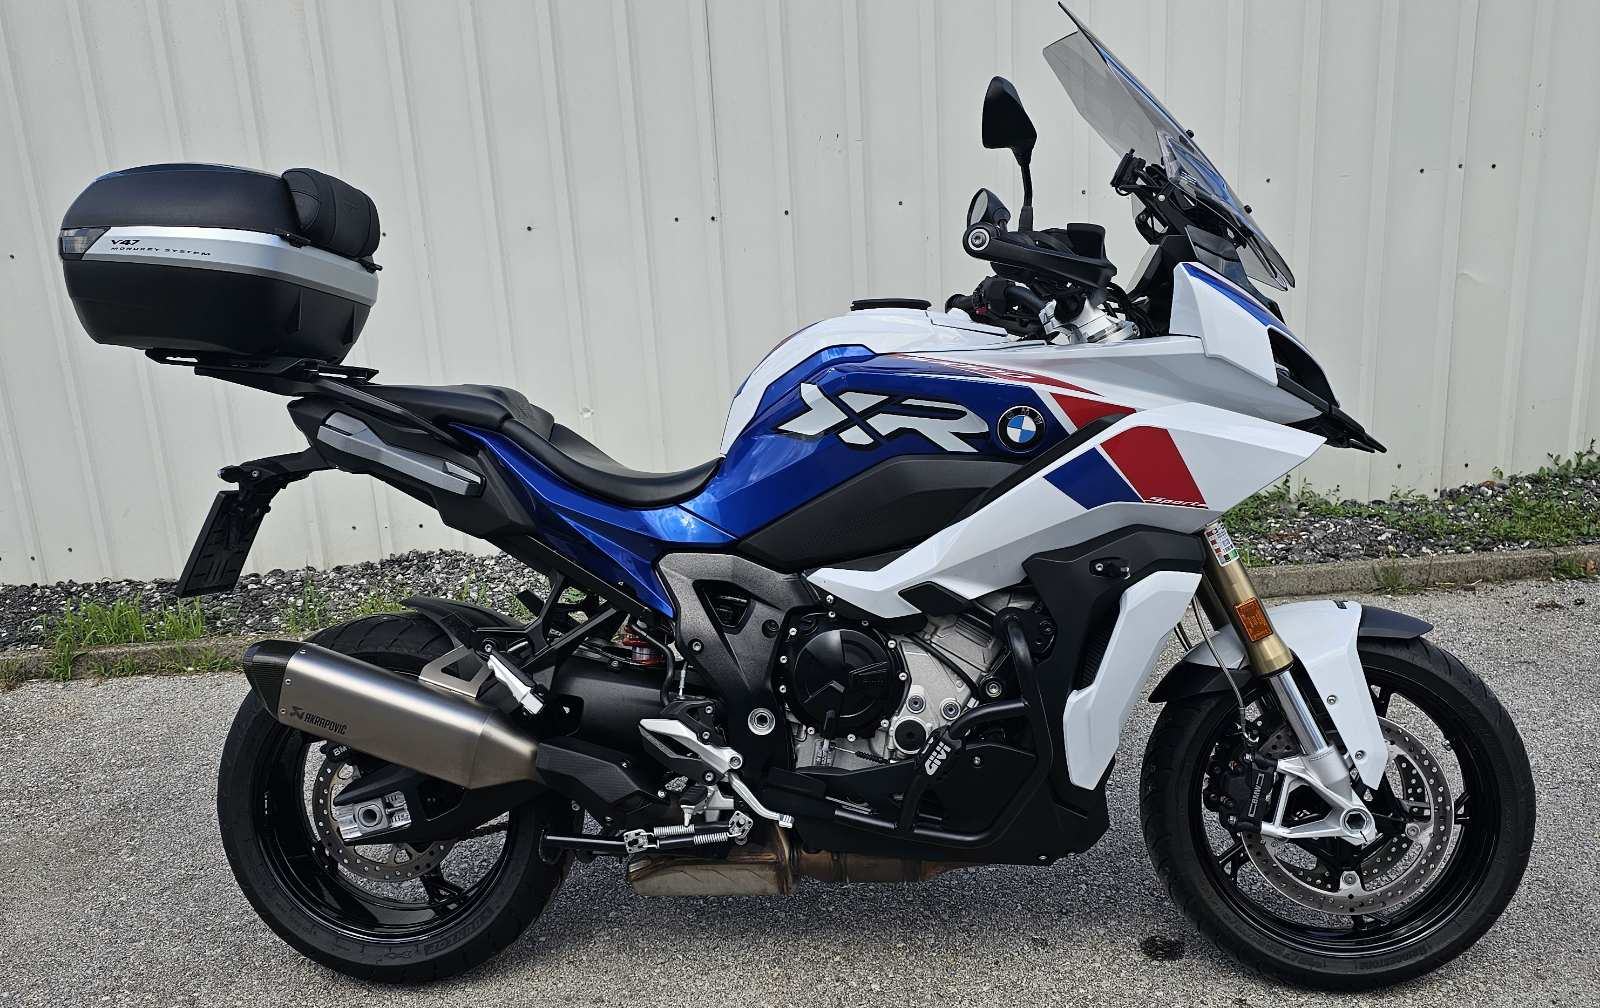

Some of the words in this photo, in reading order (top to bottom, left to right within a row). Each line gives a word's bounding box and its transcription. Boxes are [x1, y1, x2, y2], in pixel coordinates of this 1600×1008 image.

[776, 381, 990, 453] XR
[332, 745, 352, 756] BM
[925, 741, 951, 776] GIVI
